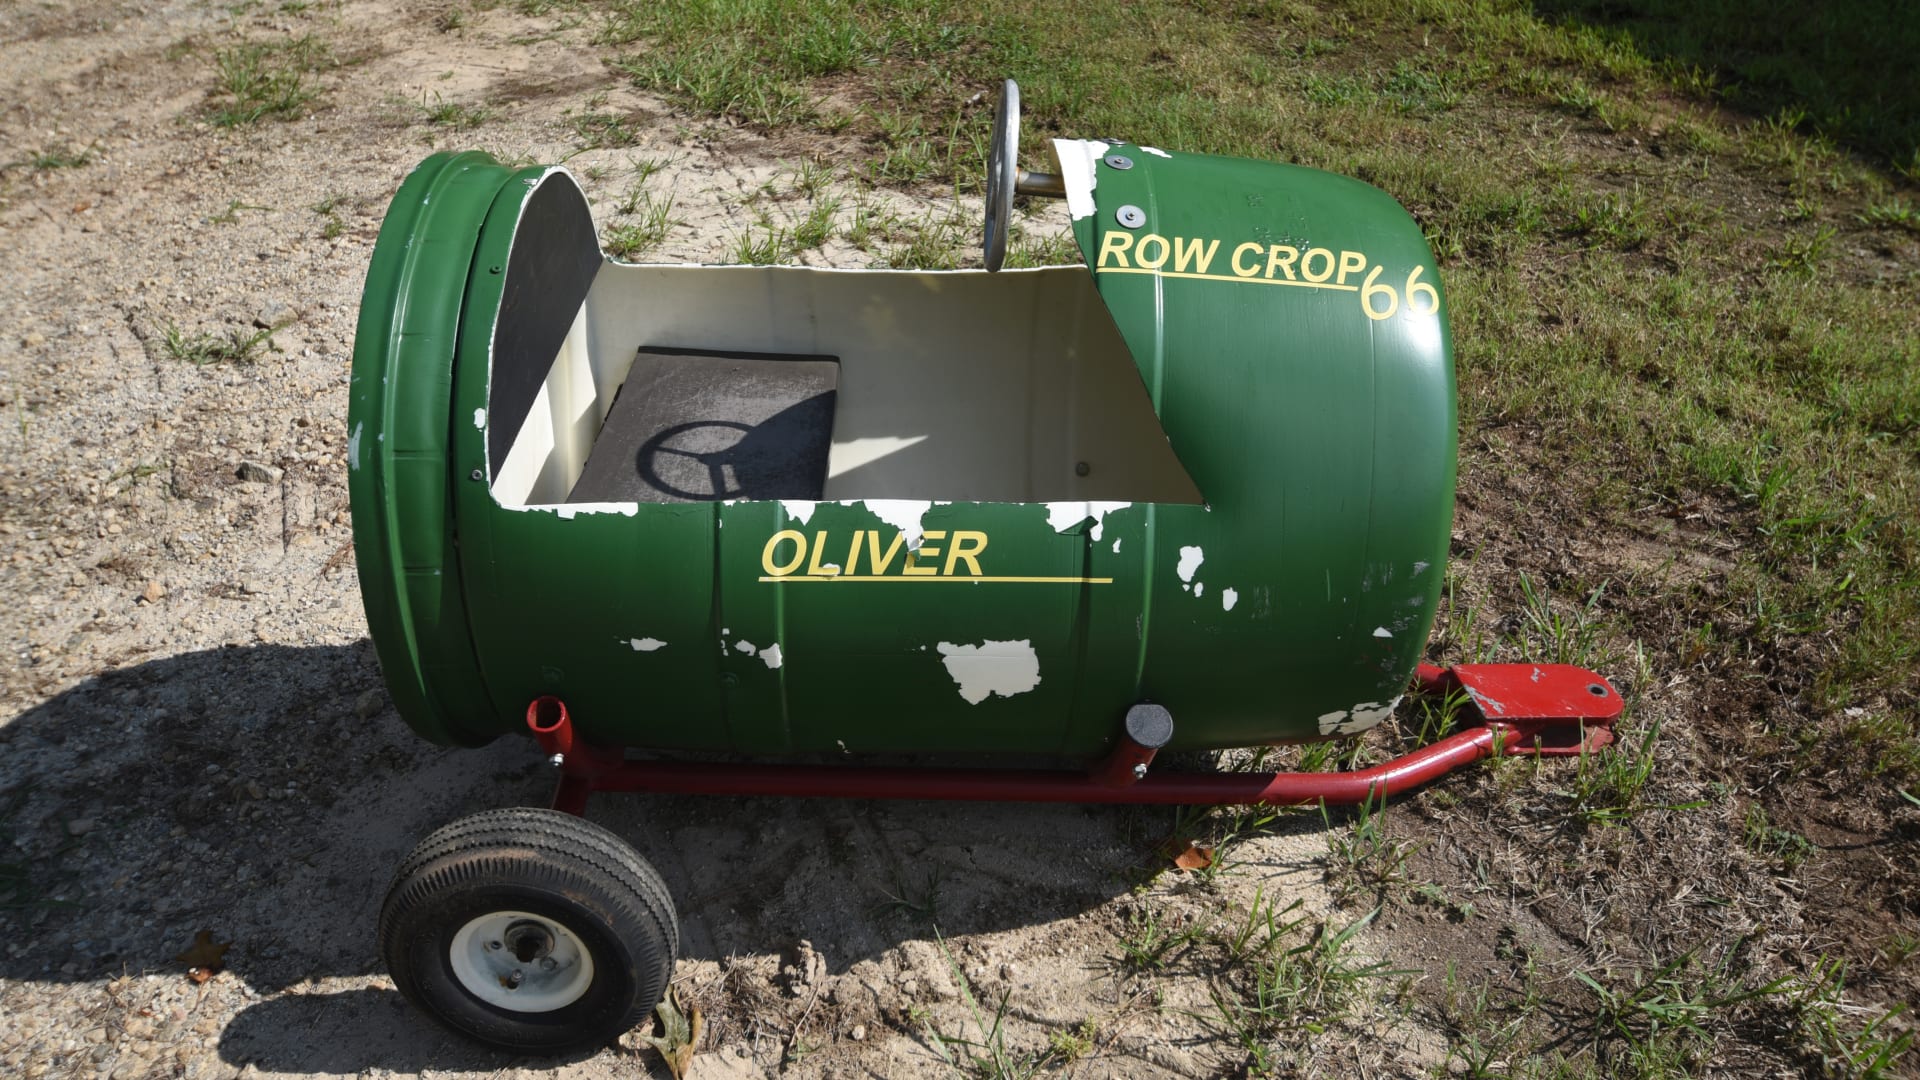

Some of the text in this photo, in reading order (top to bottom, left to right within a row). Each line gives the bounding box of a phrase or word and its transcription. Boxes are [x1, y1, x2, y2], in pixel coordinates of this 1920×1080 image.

[1098, 230, 1367, 285] ROW CROP
[1361, 264, 1440, 321] 66
[761, 529, 989, 577] OLIVER
